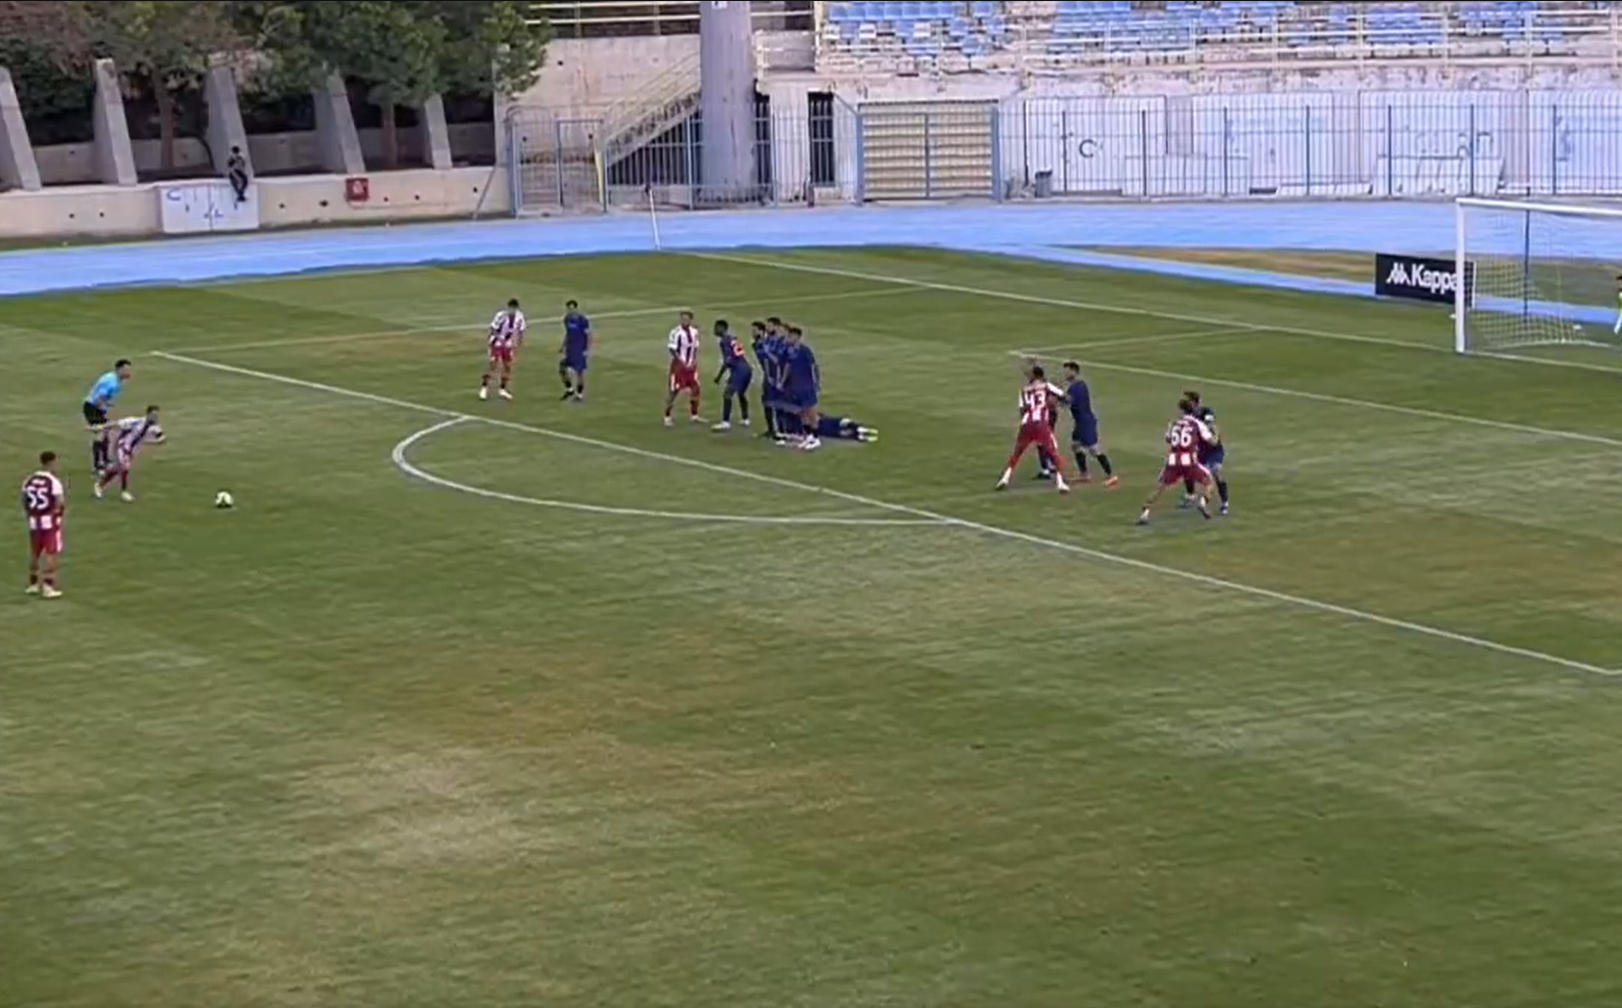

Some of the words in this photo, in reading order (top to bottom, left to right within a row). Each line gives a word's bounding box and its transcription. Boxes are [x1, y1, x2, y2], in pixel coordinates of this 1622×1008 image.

[1411, 262, 1456, 294] Kappa
[1024, 390, 1046, 409] 43
[26, 486, 49, 510] 55
